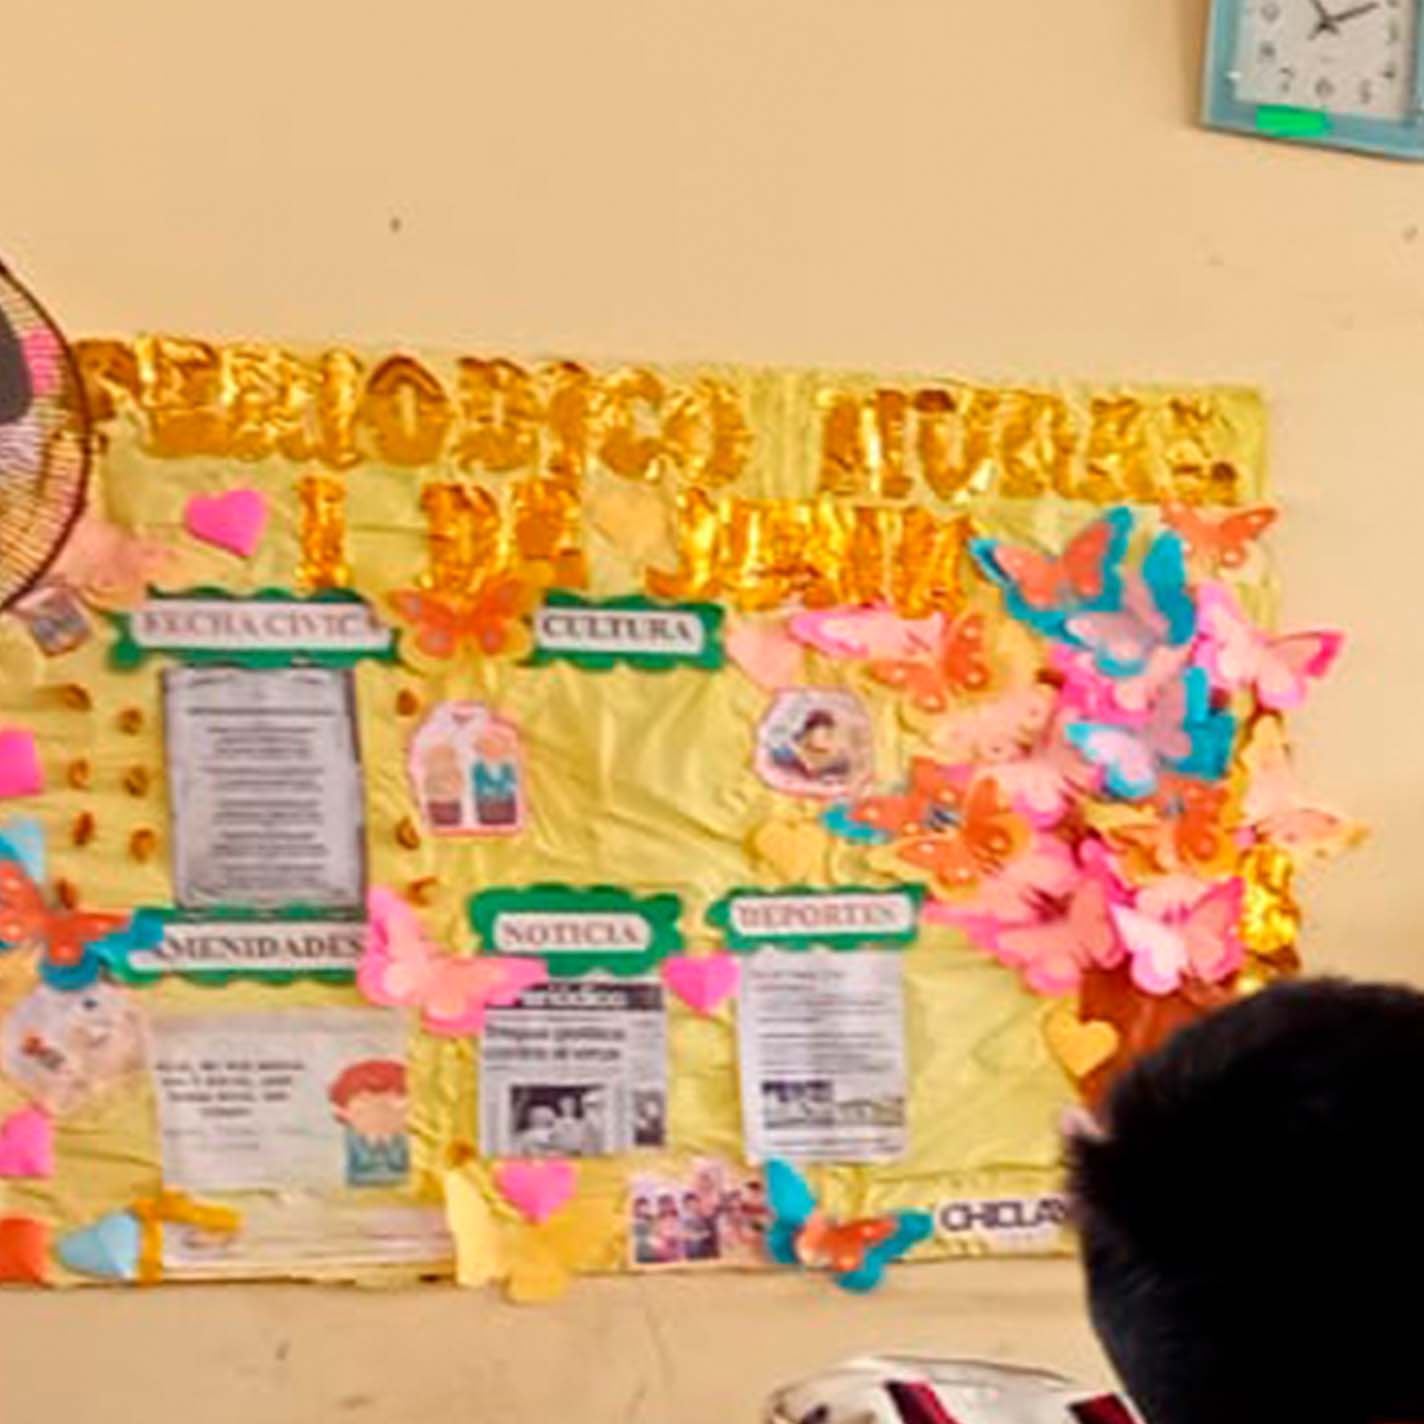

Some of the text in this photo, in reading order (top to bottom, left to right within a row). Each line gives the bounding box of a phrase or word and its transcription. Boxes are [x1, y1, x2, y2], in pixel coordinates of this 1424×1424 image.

[541, 613, 692, 643] CULTURA
[738, 902, 894, 929] DEPORTES
[502, 922, 640, 946] NOTICIA
